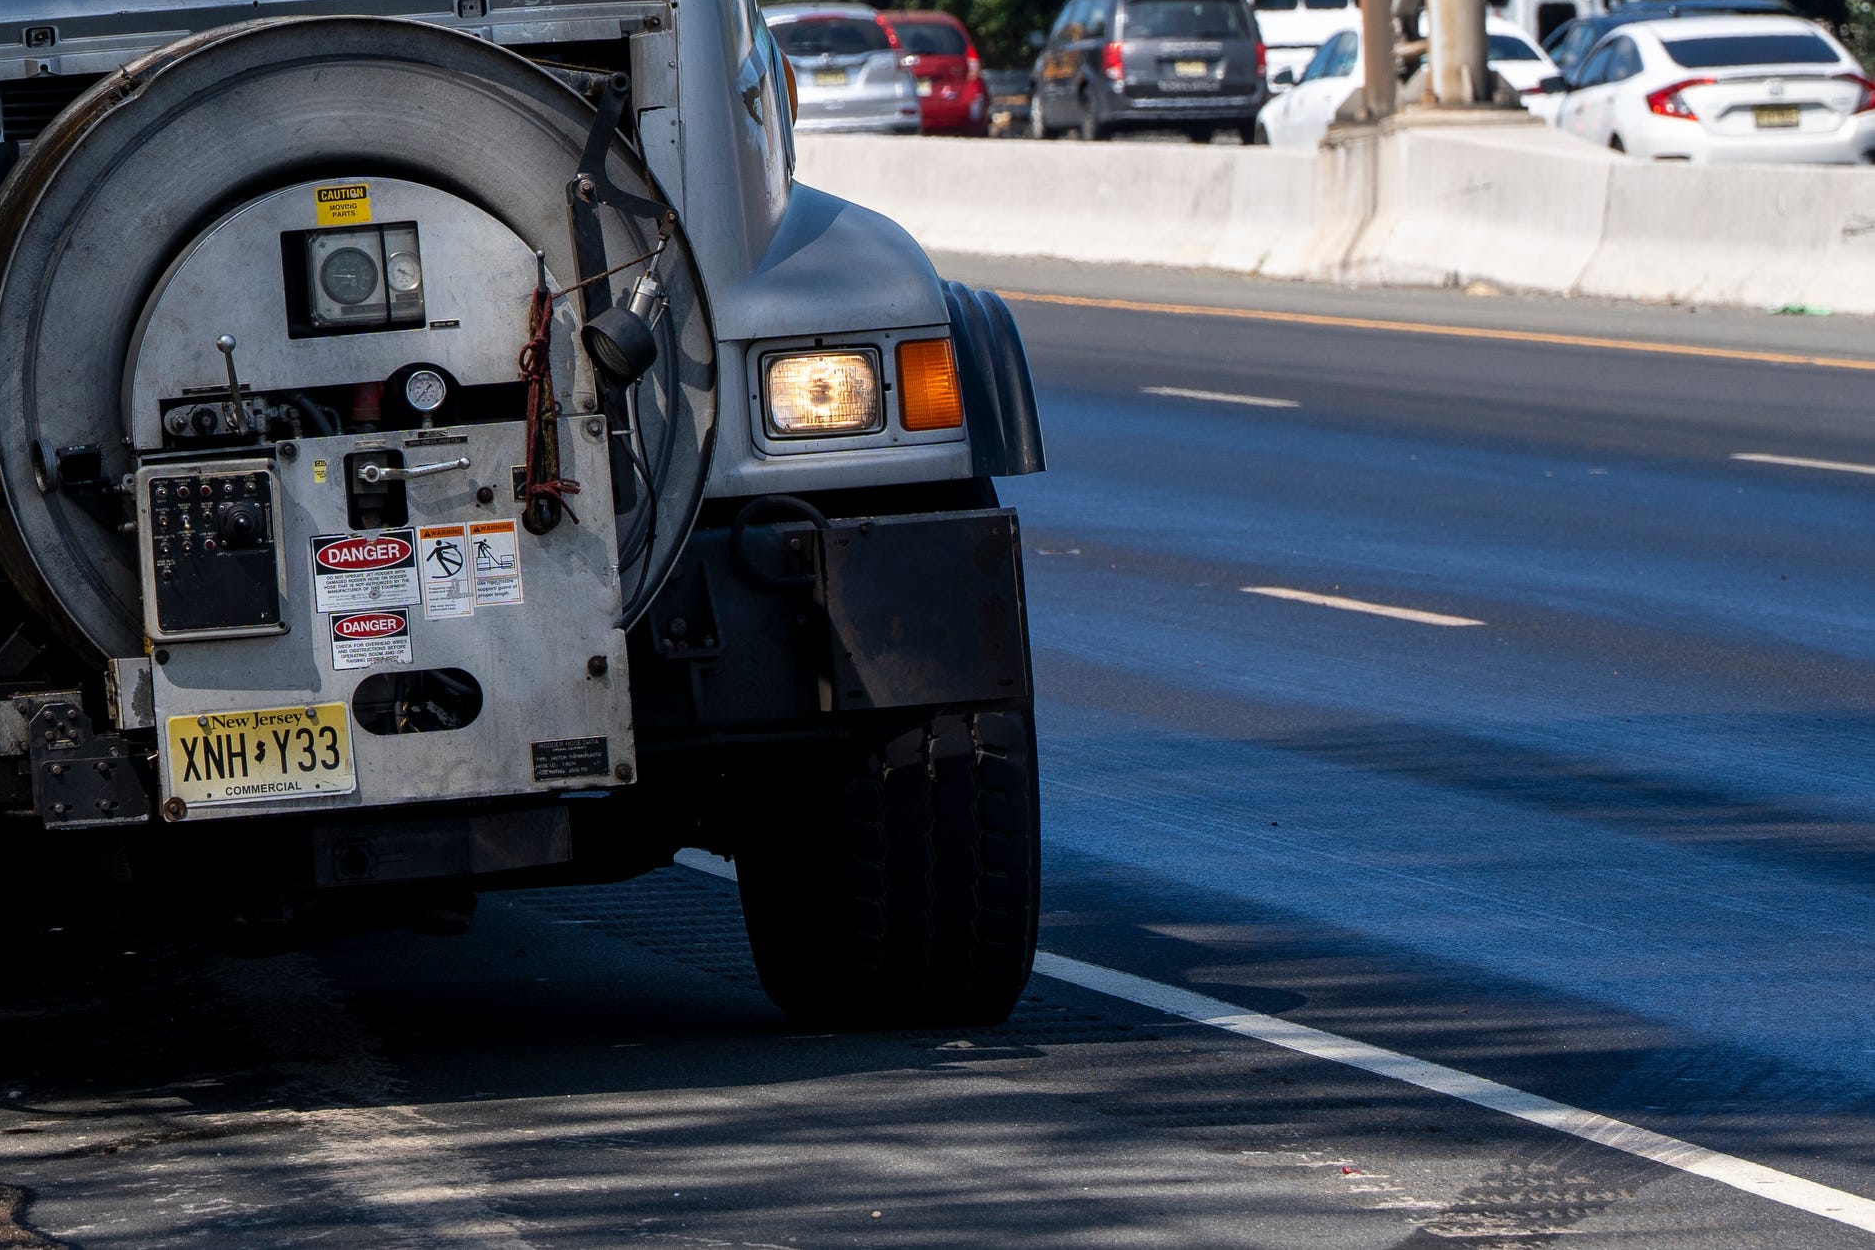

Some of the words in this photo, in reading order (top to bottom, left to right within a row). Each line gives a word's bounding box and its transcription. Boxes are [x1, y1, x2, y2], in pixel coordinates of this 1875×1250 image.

[321, 188, 364, 201] CAUTION
[330, 203, 358, 211] MOVING
[332, 210, 356, 218] PARTS
[431, 529, 463, 537] WARNING
[480, 524, 512, 532] WARNING
[327, 543, 400, 564] DANGER
[342, 618, 397, 633] DANGER
[212, 715, 252, 730] New
[252, 712, 303, 730] Jersey
[180, 732, 249, 782] XNH
[272, 725, 340, 775] Y33
[225, 781, 302, 796] COMMERCIAL
